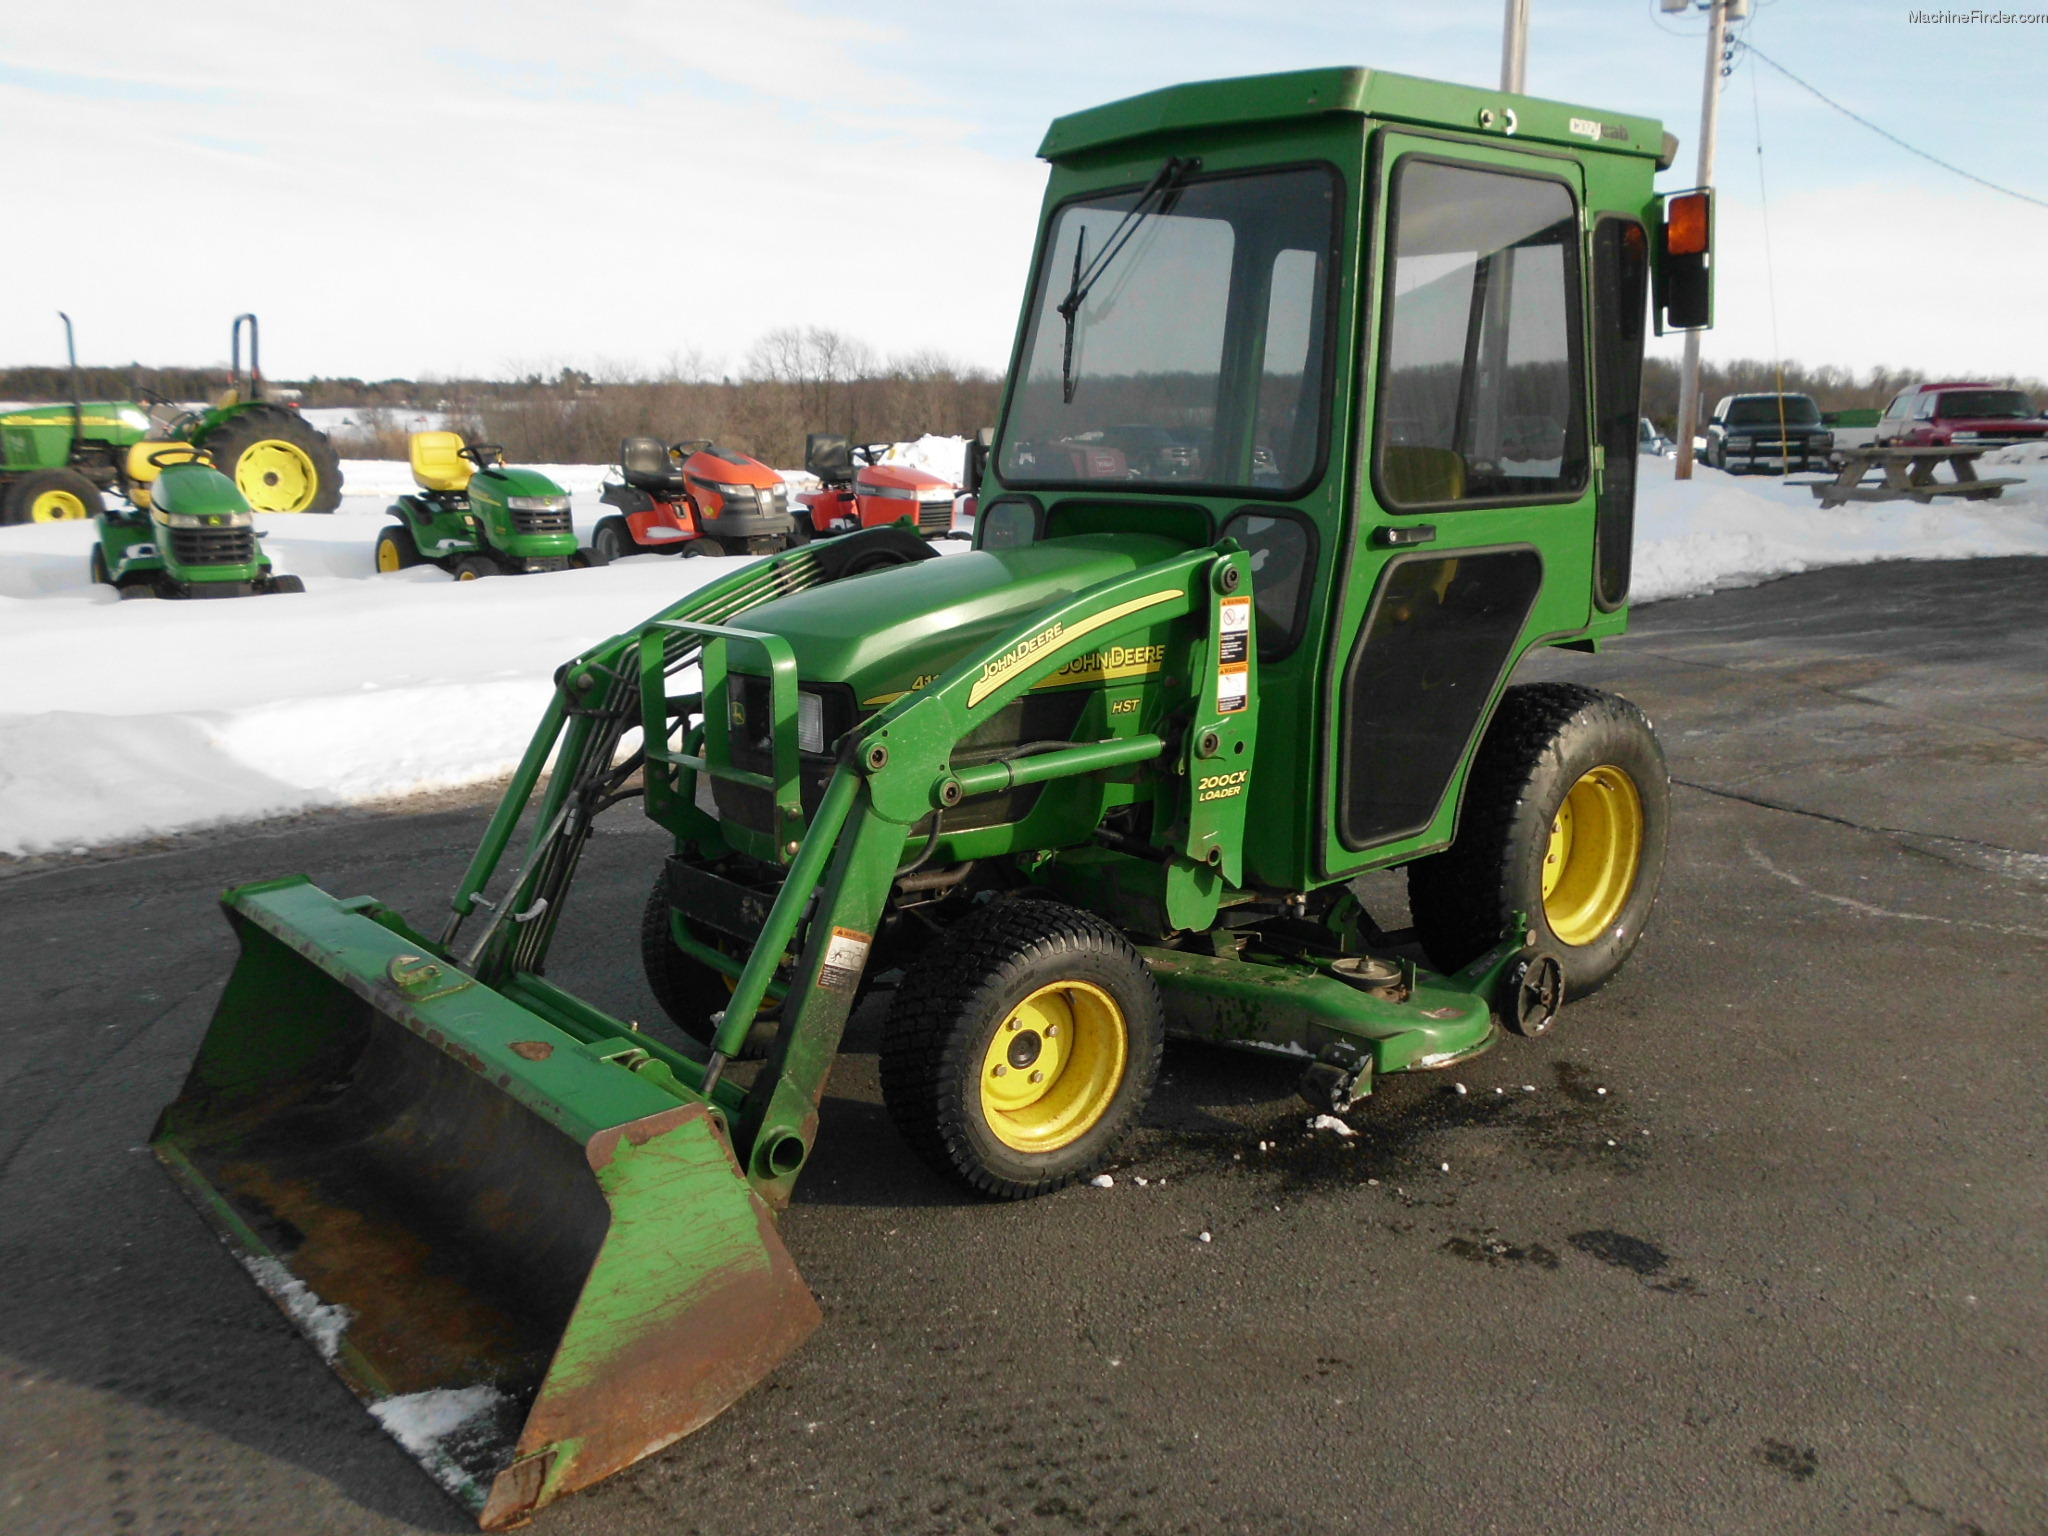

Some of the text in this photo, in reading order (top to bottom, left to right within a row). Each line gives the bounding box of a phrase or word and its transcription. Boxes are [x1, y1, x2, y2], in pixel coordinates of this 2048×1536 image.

[980, 622, 1063, 682] JOHN DEERE
[1111, 645, 1165, 668] DEERE
[1111, 699, 1141, 714] HST
[1198, 770, 1248, 790] 200CX
[1199, 785, 1242, 802] LOADER
